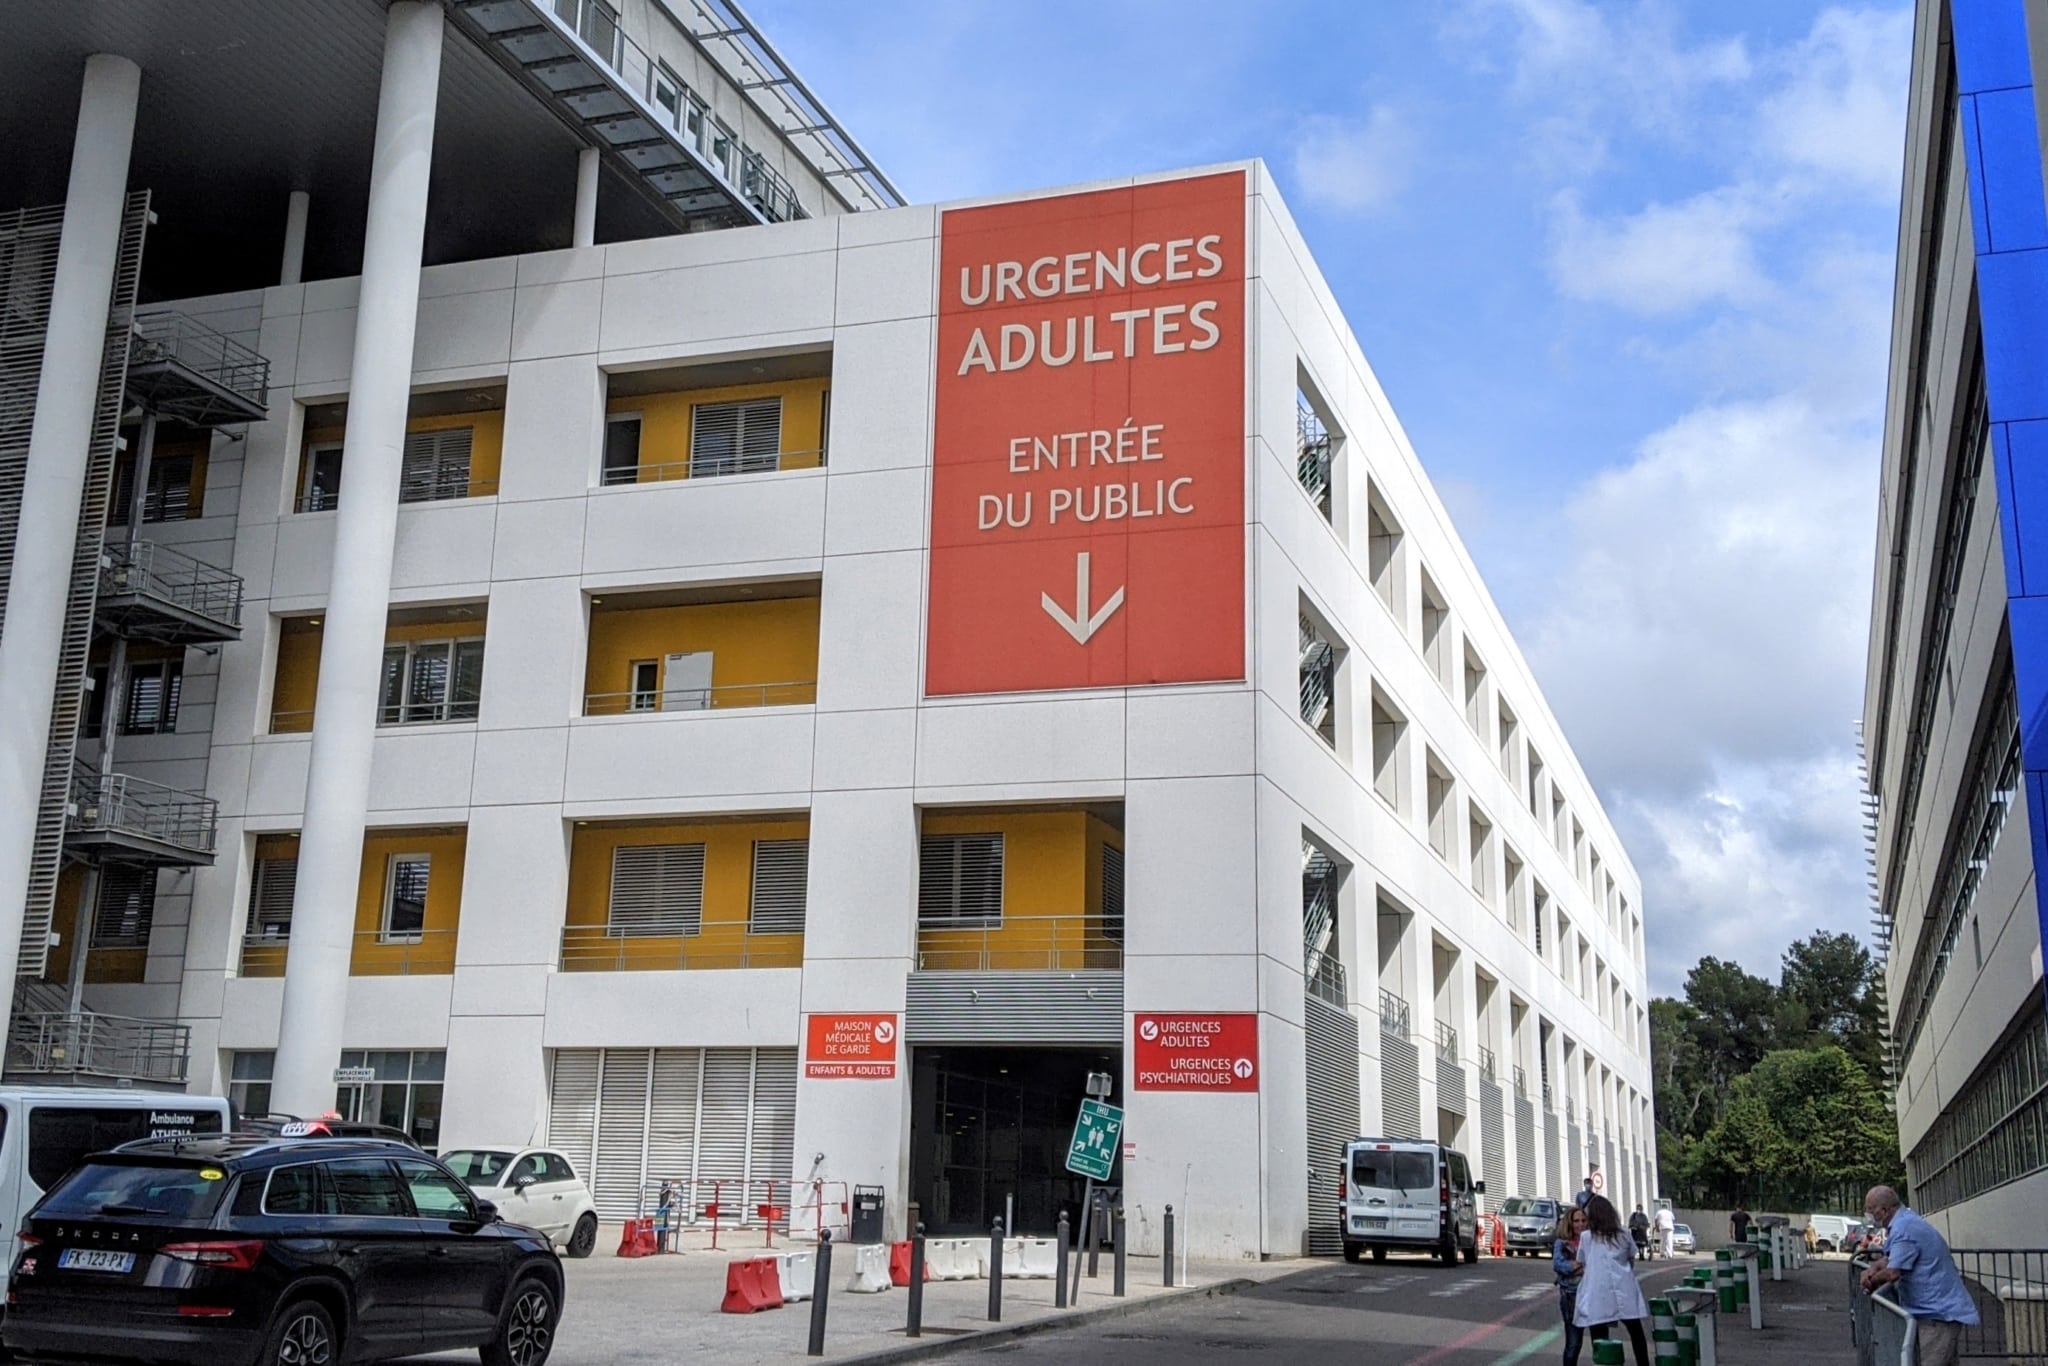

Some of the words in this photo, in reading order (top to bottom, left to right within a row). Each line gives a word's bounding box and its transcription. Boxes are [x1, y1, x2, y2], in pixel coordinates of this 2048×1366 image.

[960, 235, 1223, 306] URGENCES
[957, 300, 1221, 376] ADULTES
[1009, 417, 1164, 473] ENTRÉE
[978, 494, 1032, 530] DU
[1050, 476, 1194, 525] PUBLIC
[834, 1021, 872, 1032] MAISON
[1160, 1021, 1222, 1033] URGENCES
[825, 1031, 872, 1043] MÉDICALE
[1160, 1035, 1211, 1048] ADULTES
[825, 1044, 838, 1055] DE
[839, 1044, 872, 1055] GARDE
[809, 1065, 846, 1075] ENFANTS
[847, 1065, 854, 1075] &
[855, 1065, 892, 1075] ADULTES
[1170, 1058, 1232, 1070] URGENCES
[1139, 1072, 1232, 1086] PSYCHIATRIQUES
[1096, 1105, 1110, 1116] IHU
[150, 1111, 195, 1125] Ambulance
[68, 1250, 126, 1268] FK-123-PX
